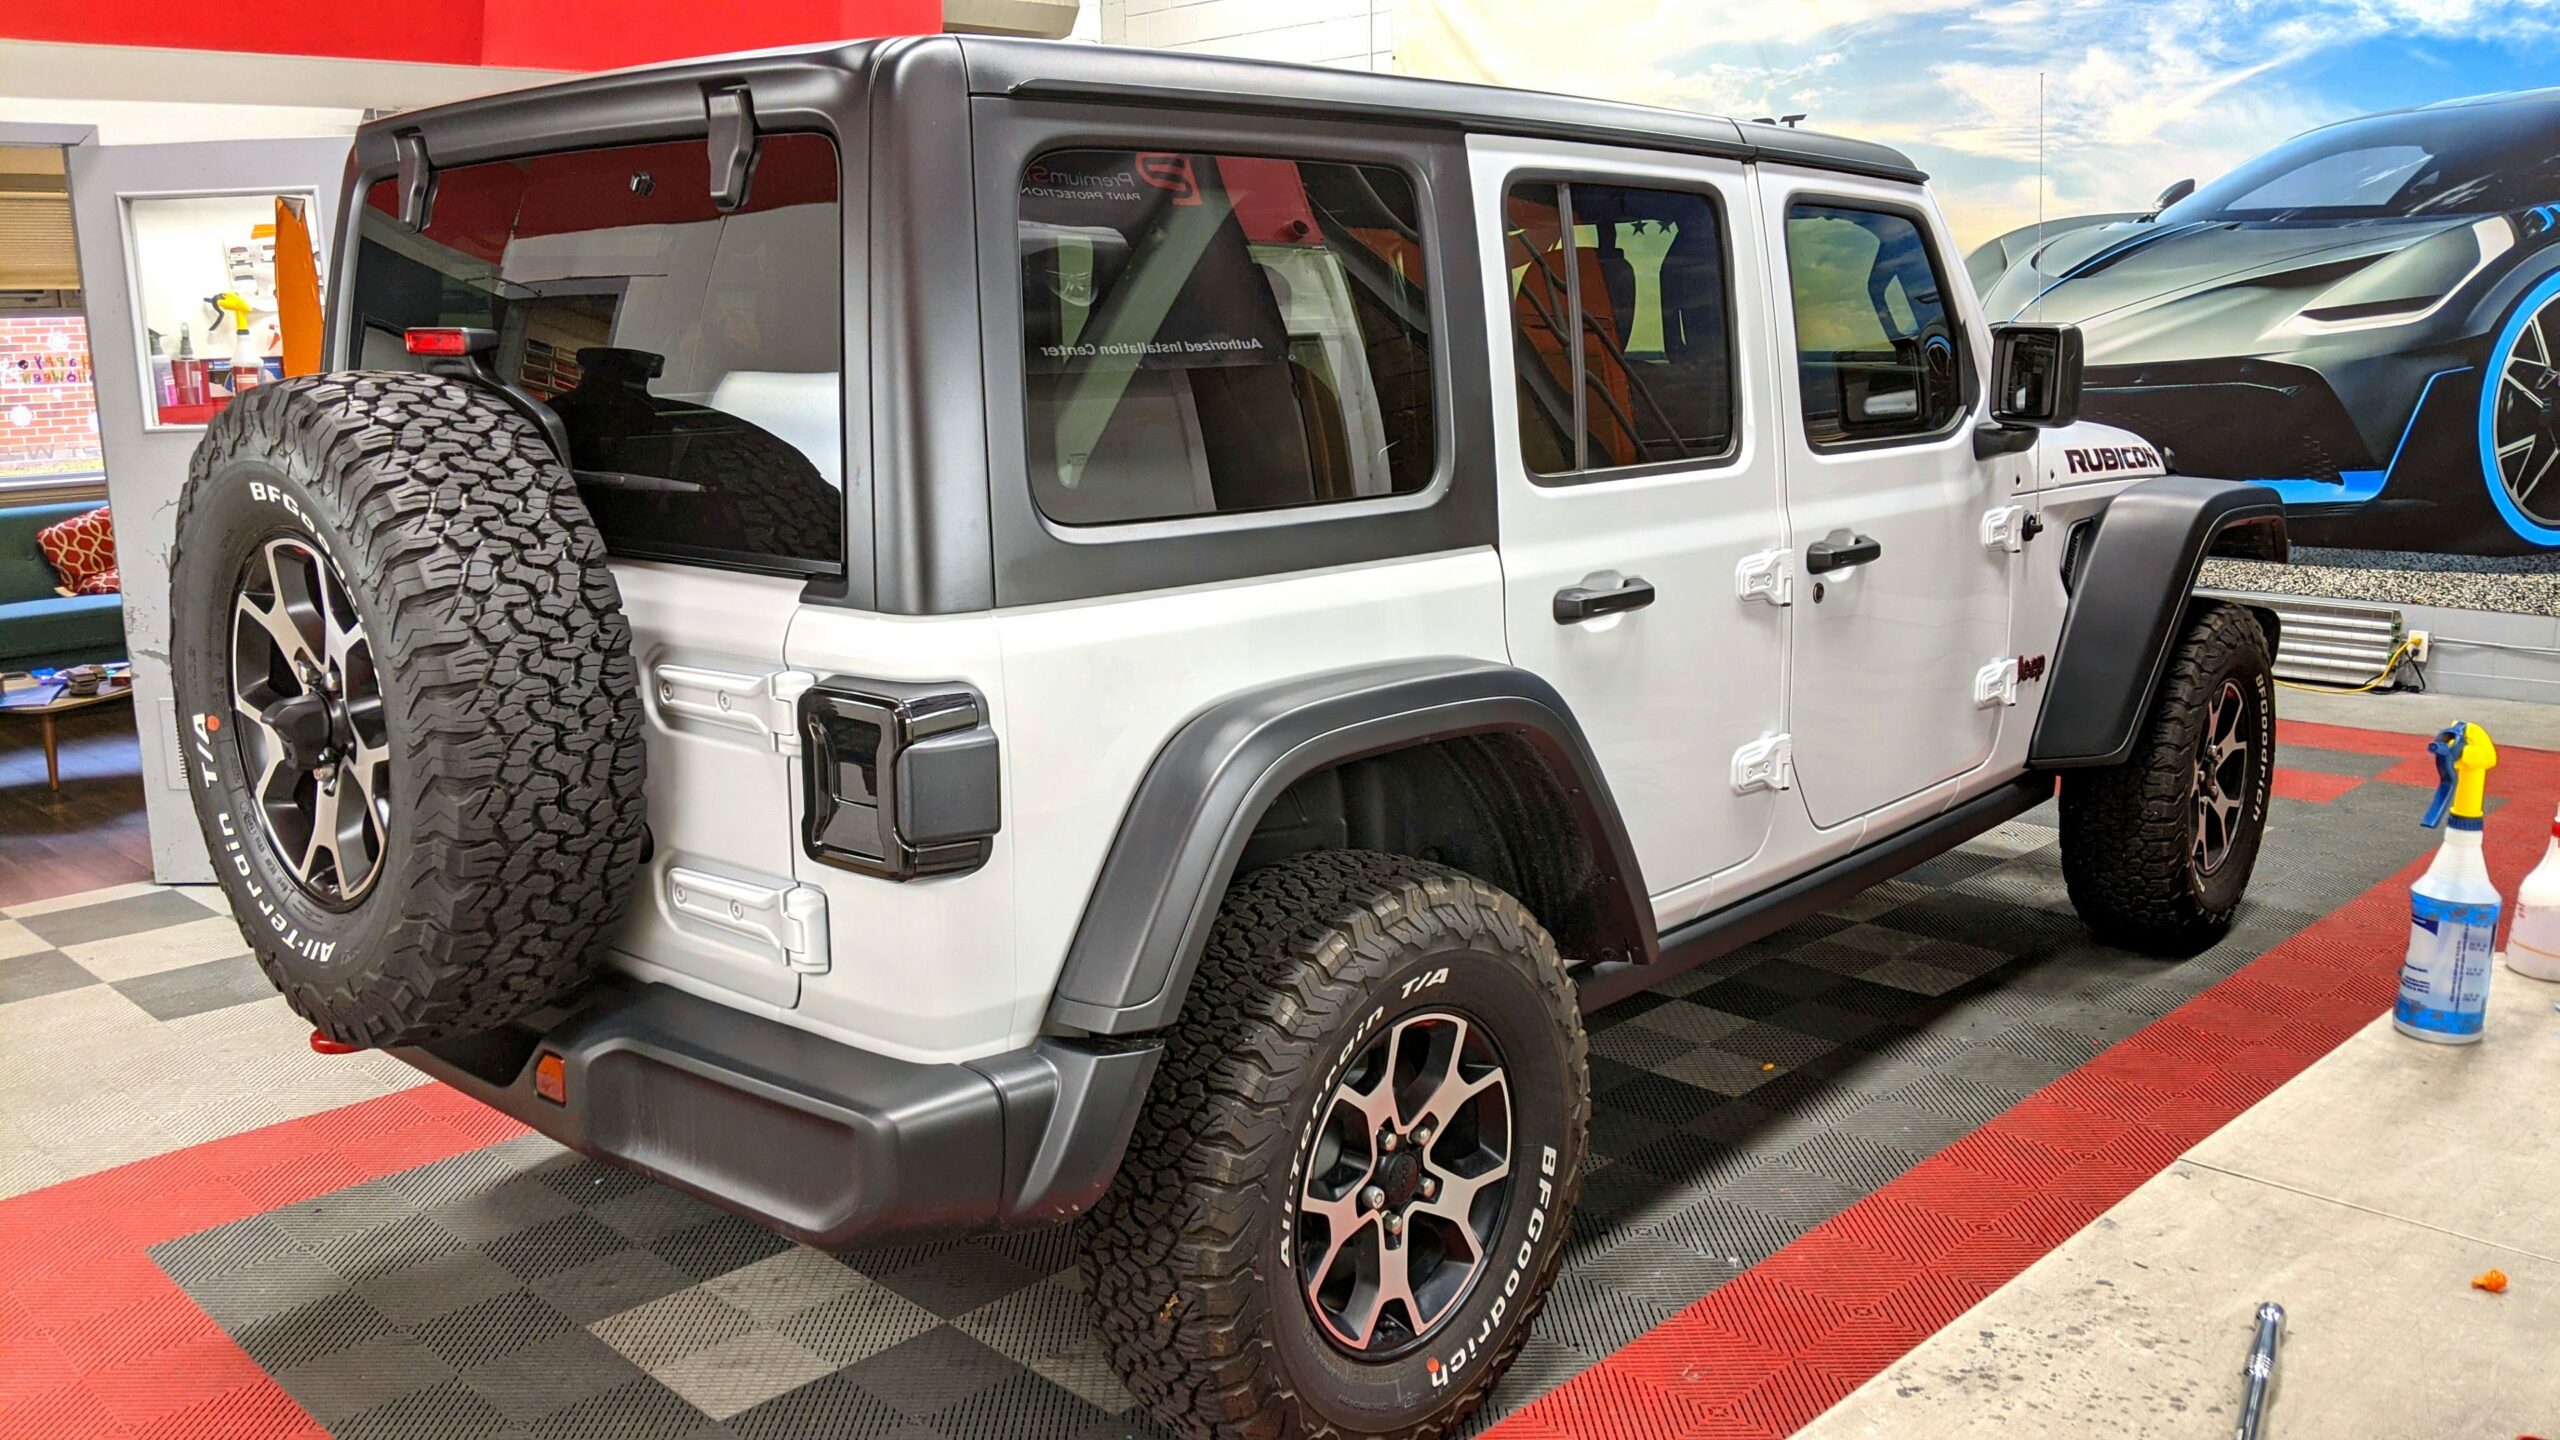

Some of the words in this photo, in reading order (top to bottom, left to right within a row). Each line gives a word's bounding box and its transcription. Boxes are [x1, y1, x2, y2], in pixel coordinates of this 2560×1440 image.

[2064, 446, 2160, 474] RUBICON
[2017, 655, 2046, 683] Jeep
[192, 713, 219, 789] T/A
[2254, 673, 2269, 822] BFGoodrich
[219, 812, 337, 963] All-Terrain
[1280, 1005, 1384, 1268] All-Terrain
[1401, 967, 1449, 999] T/A
[1431, 1145, 1557, 1388] BFGoodrich
